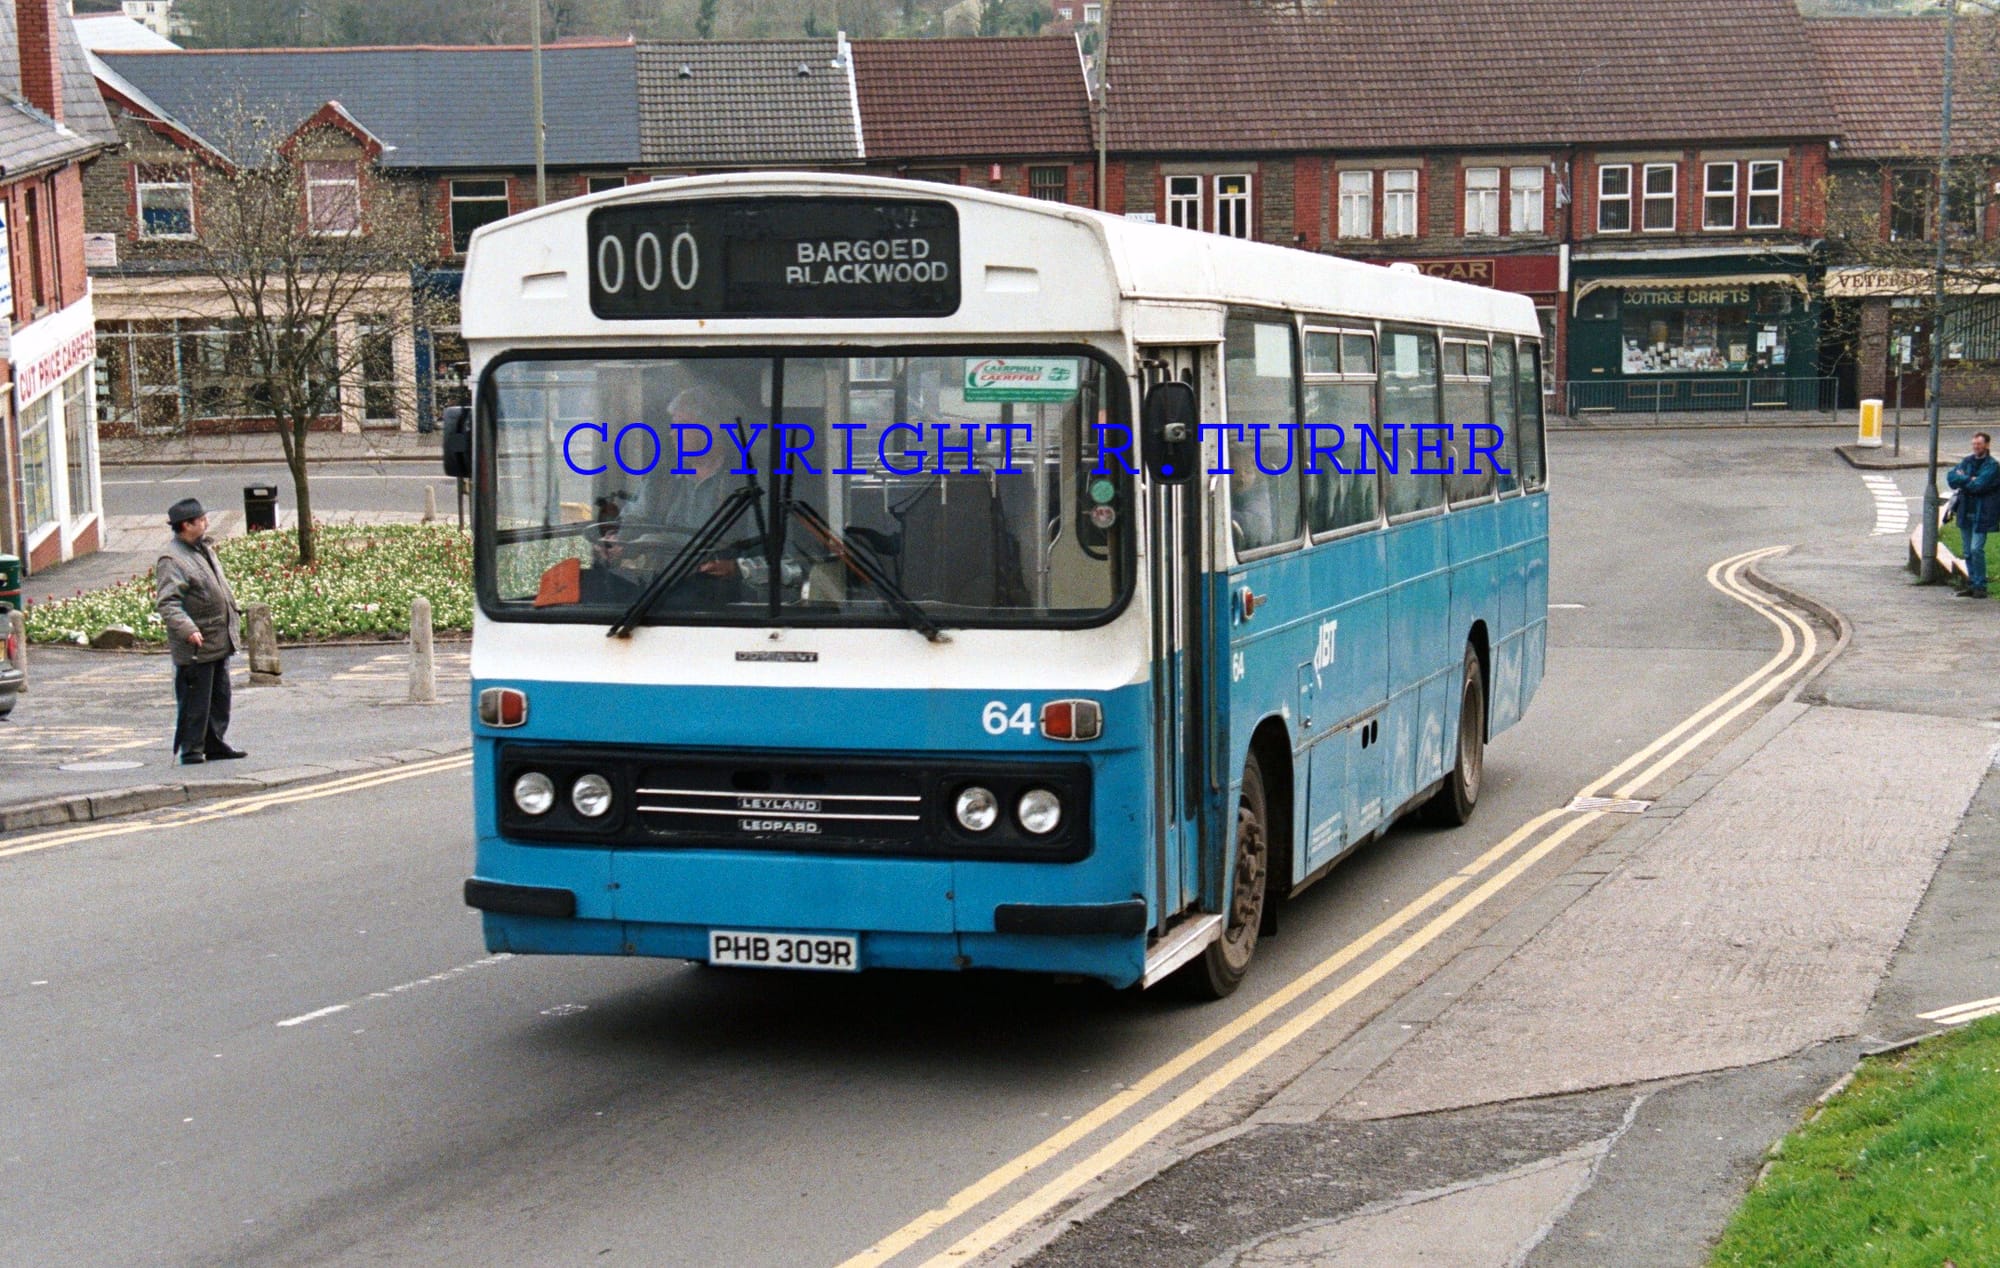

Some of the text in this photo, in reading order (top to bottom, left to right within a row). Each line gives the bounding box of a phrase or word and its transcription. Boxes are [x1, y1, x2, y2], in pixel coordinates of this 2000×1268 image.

[796, 238, 930, 263] BARGOED
[785, 261, 948, 285] BLACKWOOD
[1623, 288, 1750, 305] COTTAGE CRAFTS
[19, 328, 95, 402] CUT PRICE CARPETS
[1233, 650, 1245, 682] 64
[982, 700, 1036, 735] 64
[742, 798, 817, 811] LEYLAND
[742, 820, 817, 832] LEOPARD
[714, 935, 852, 965] PHB 309R
